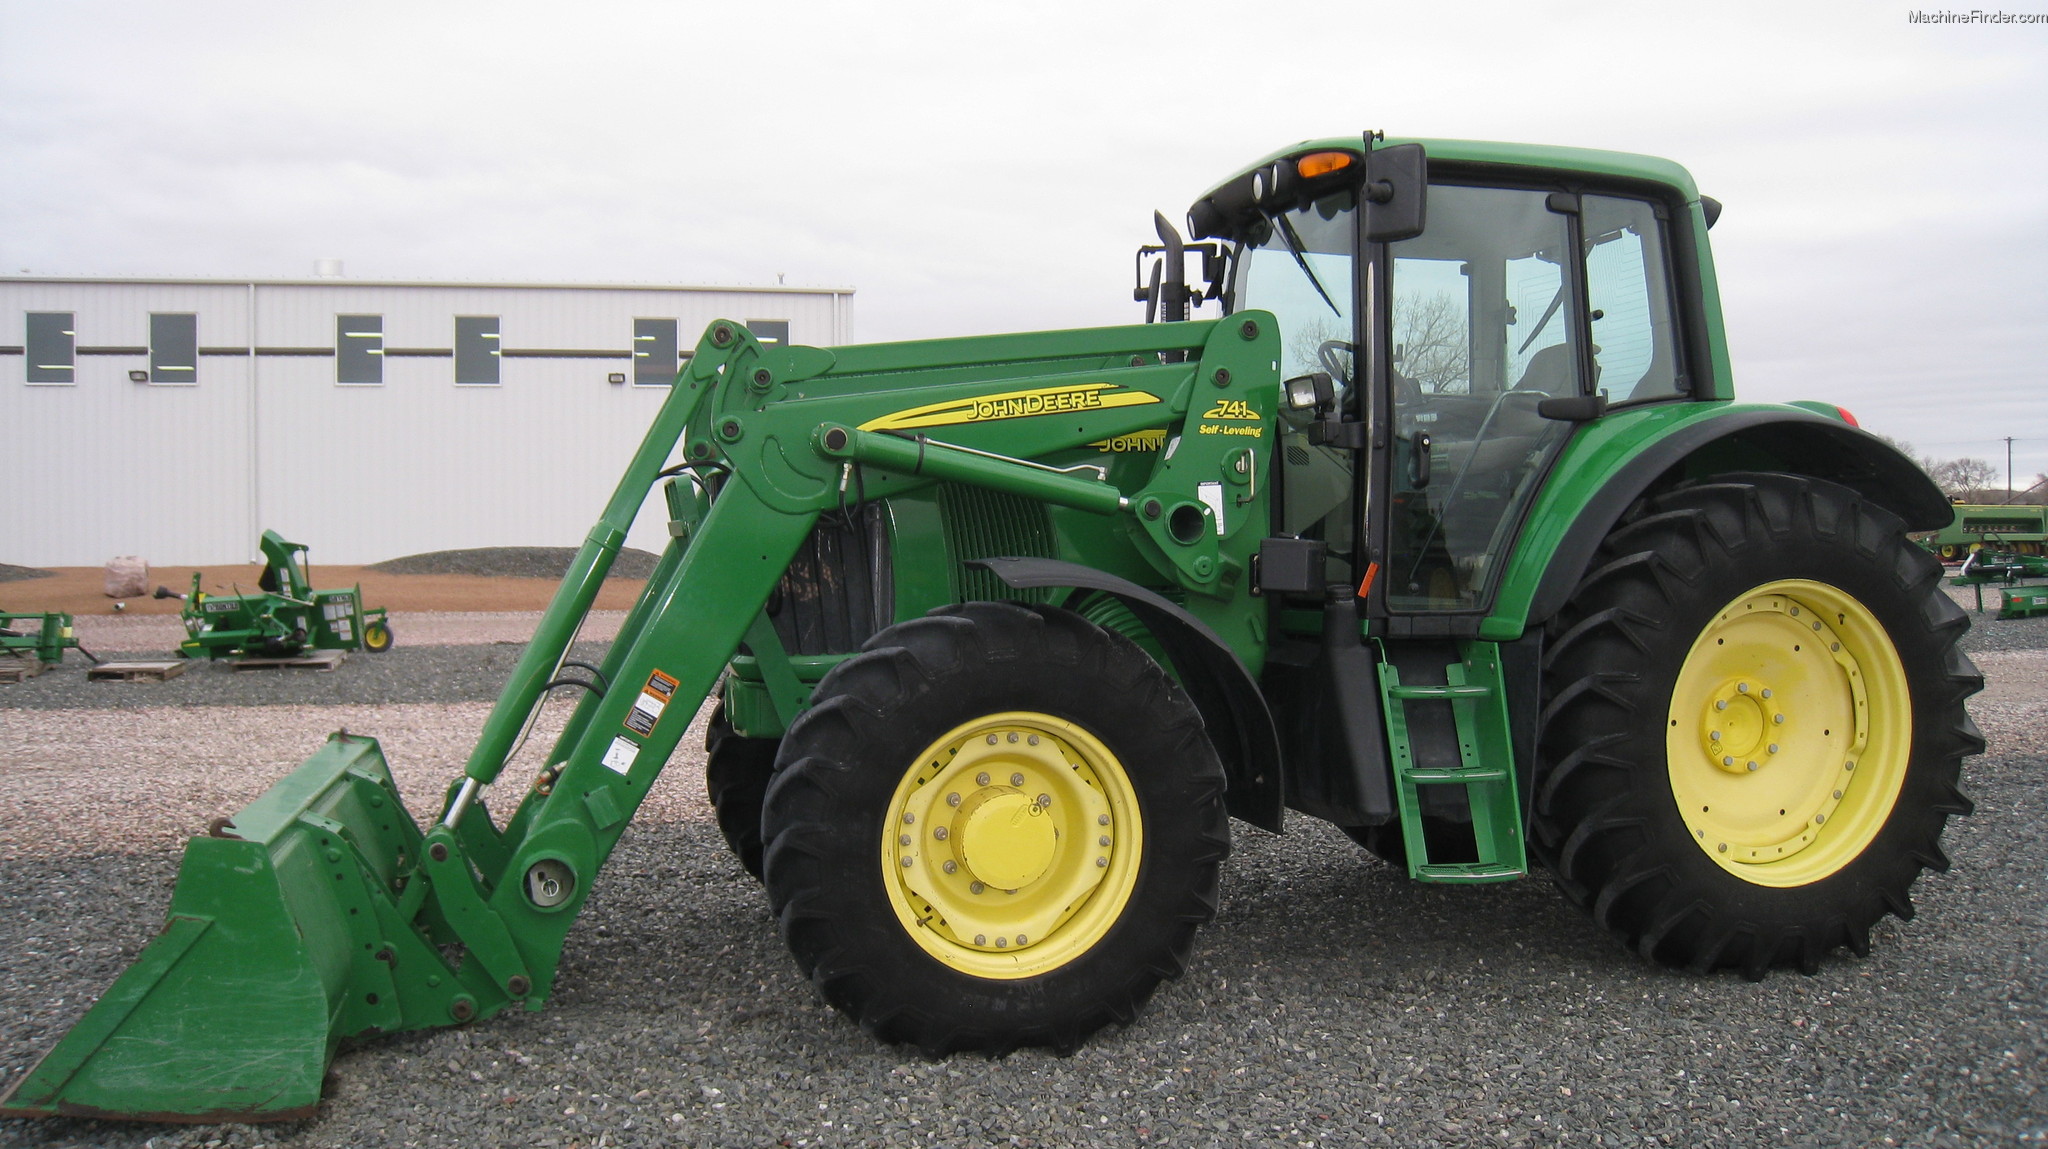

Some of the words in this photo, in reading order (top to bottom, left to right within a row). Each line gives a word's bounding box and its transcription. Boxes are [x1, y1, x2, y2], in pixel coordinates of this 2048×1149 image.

[967, 400, 1023, 419] JOHN
[1026, 390, 1101, 413] DEERE
[1216, 400, 1247, 417] 741
[1099, 437, 1157, 453] JOHN
